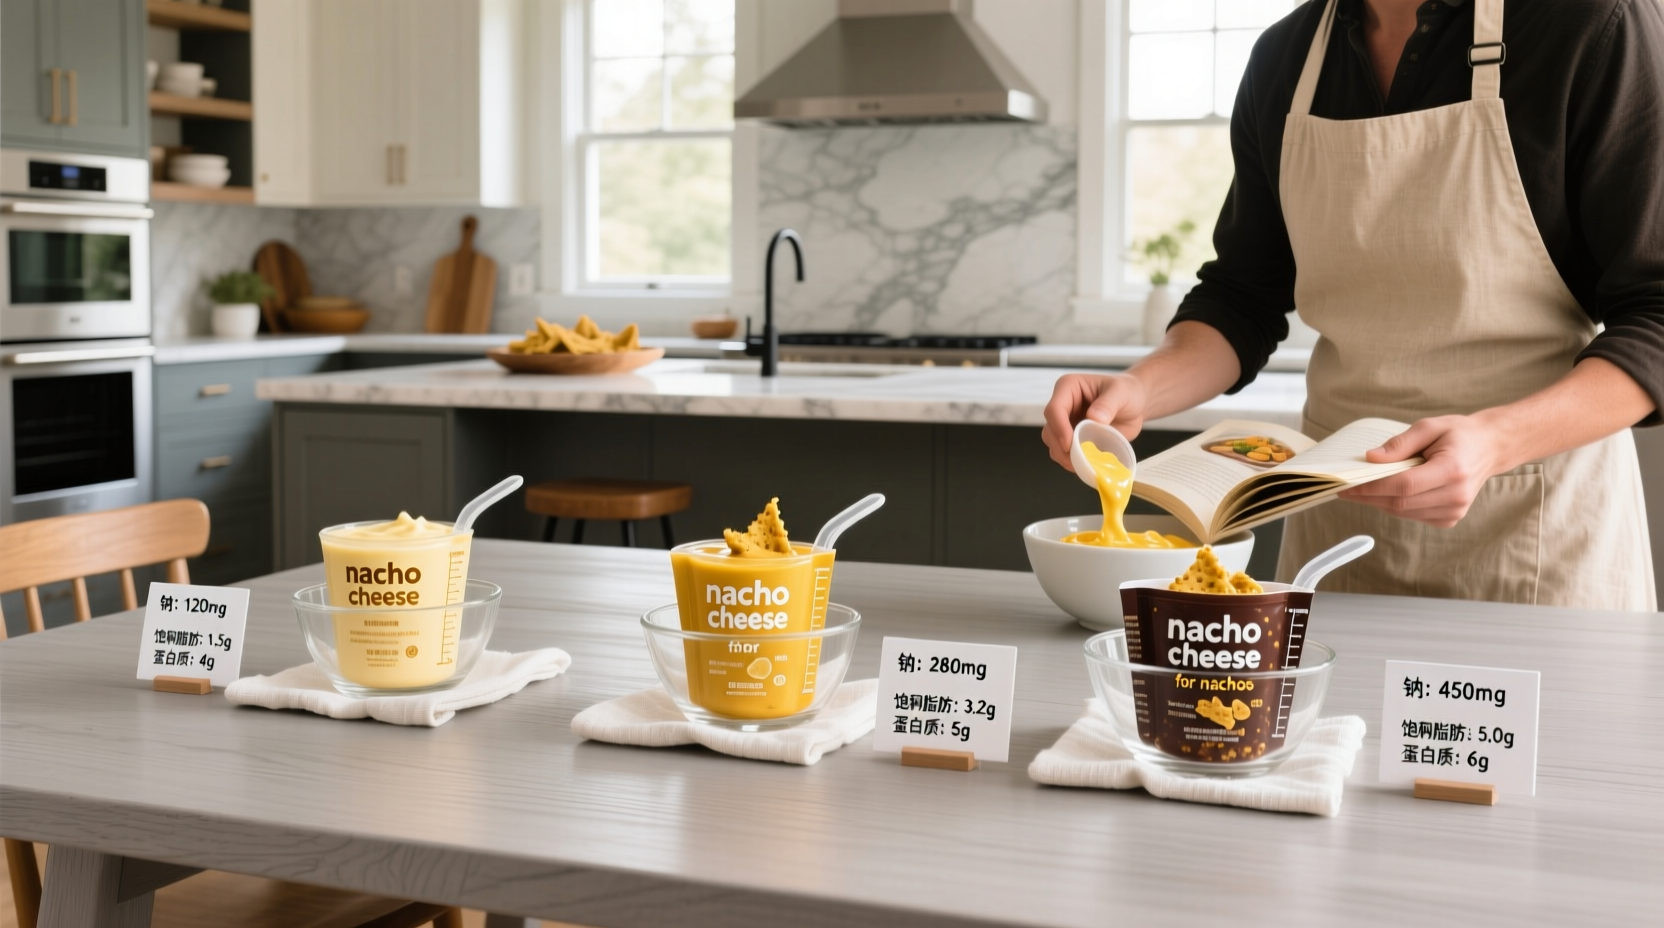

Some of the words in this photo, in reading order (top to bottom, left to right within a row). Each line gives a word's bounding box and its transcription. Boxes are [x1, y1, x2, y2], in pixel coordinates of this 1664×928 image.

[345, 561, 422, 585] nacho
[348, 586, 420, 606] cheese
[706, 579, 790, 606] nacho
[707, 605, 789, 630] cheese
[1167, 614, 1262, 644] nacho
[199, 653, 215, 672] 4g
[1167, 641, 1262, 670] cheese
[928, 656, 987, 681] 280mg
[1175, 673, 1197, 689] for
[1438, 680, 1506, 708] 450mg
[963, 698, 996, 721] 3.2g
[951, 721, 971, 742] 5g
[1478, 725, 1515, 750] 5.0g
[1466, 750, 1490, 773] 6g
